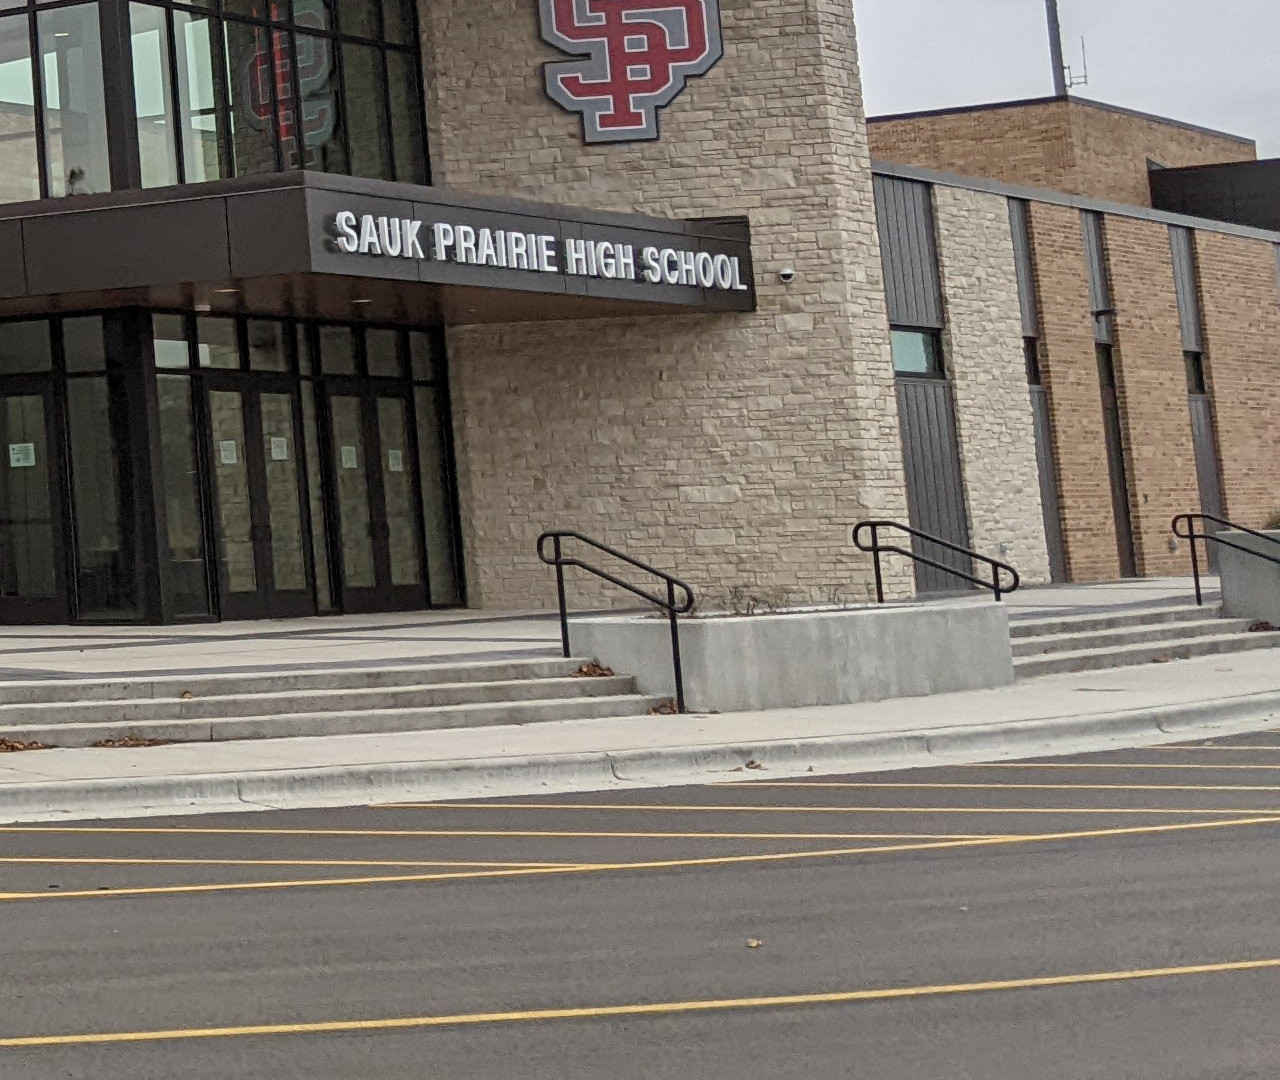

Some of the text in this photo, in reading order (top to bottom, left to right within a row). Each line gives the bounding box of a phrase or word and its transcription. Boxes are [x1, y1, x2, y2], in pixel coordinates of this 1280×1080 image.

[335, 211, 748, 291] SAUK PRAIRIE HIGH SCHOOL
